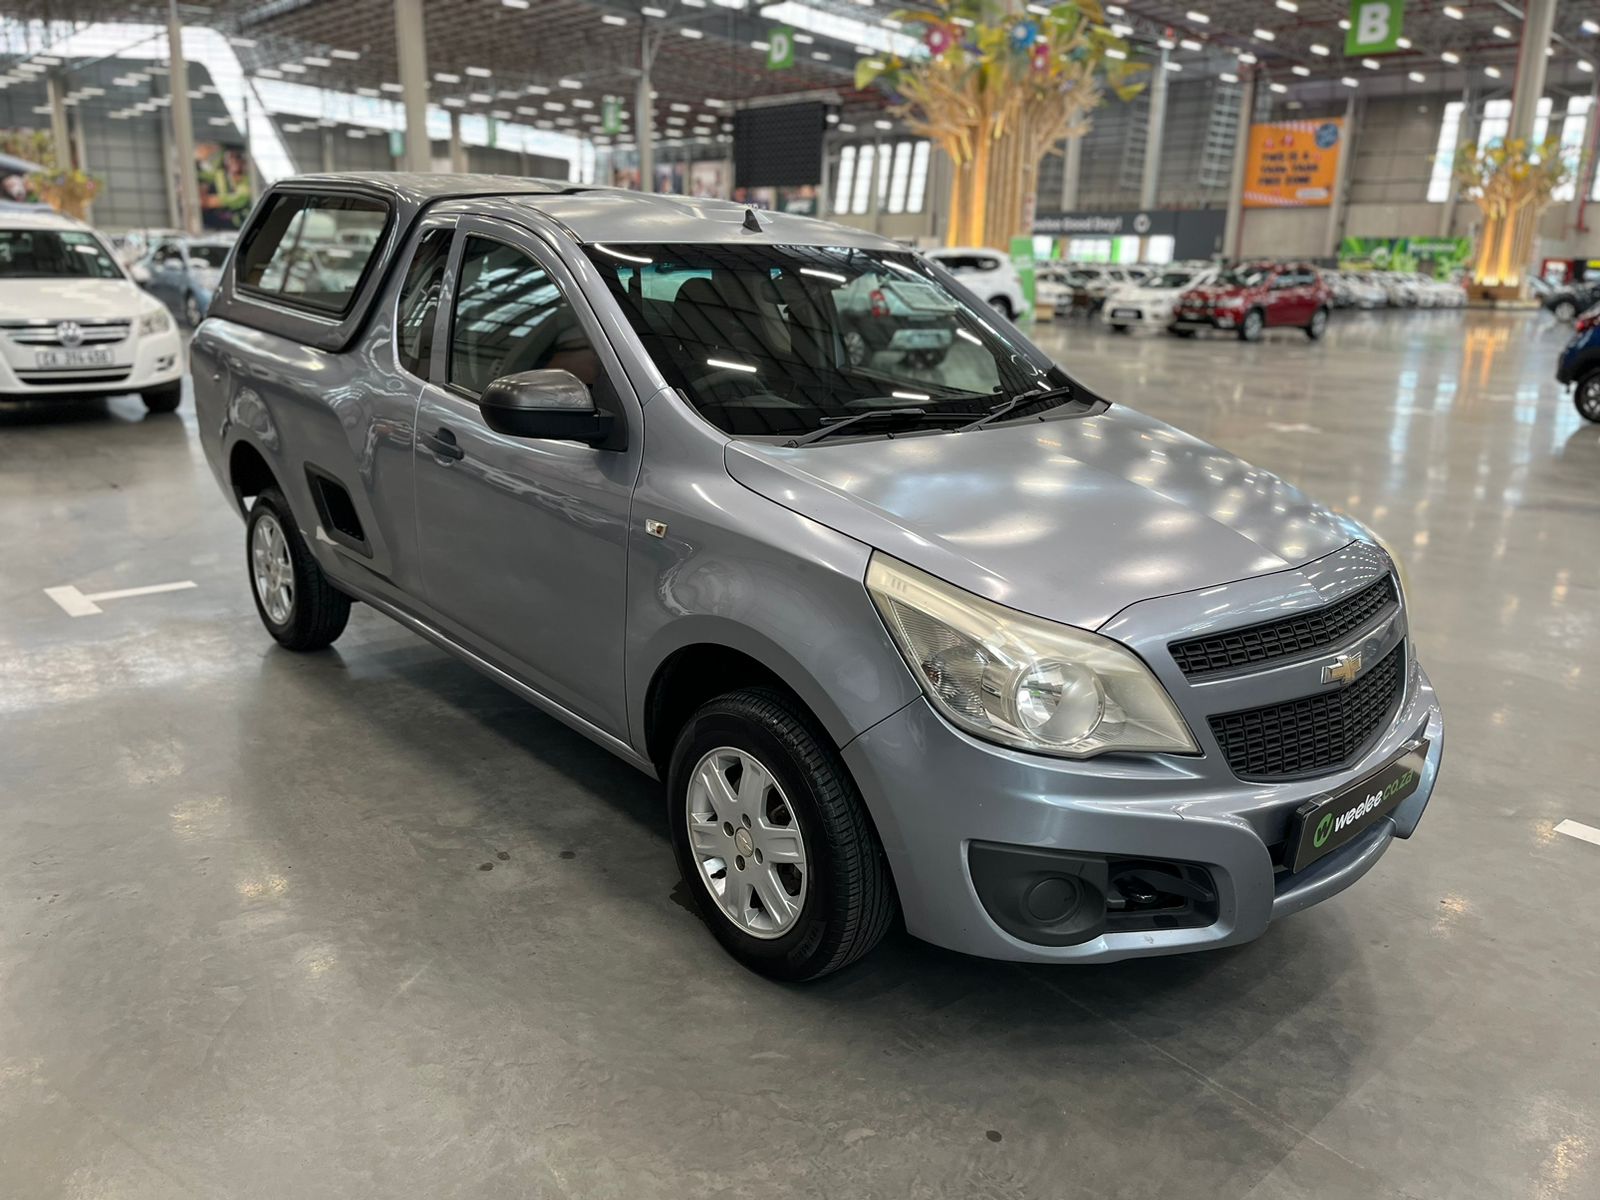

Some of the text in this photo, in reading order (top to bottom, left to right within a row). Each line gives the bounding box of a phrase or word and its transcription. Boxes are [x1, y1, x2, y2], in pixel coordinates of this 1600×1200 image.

[1357, 1, 1391, 44] B
[770, 32, 788, 63] D
[1063, 215, 1090, 231] Good
[1093, 215, 1123, 232] Day!
